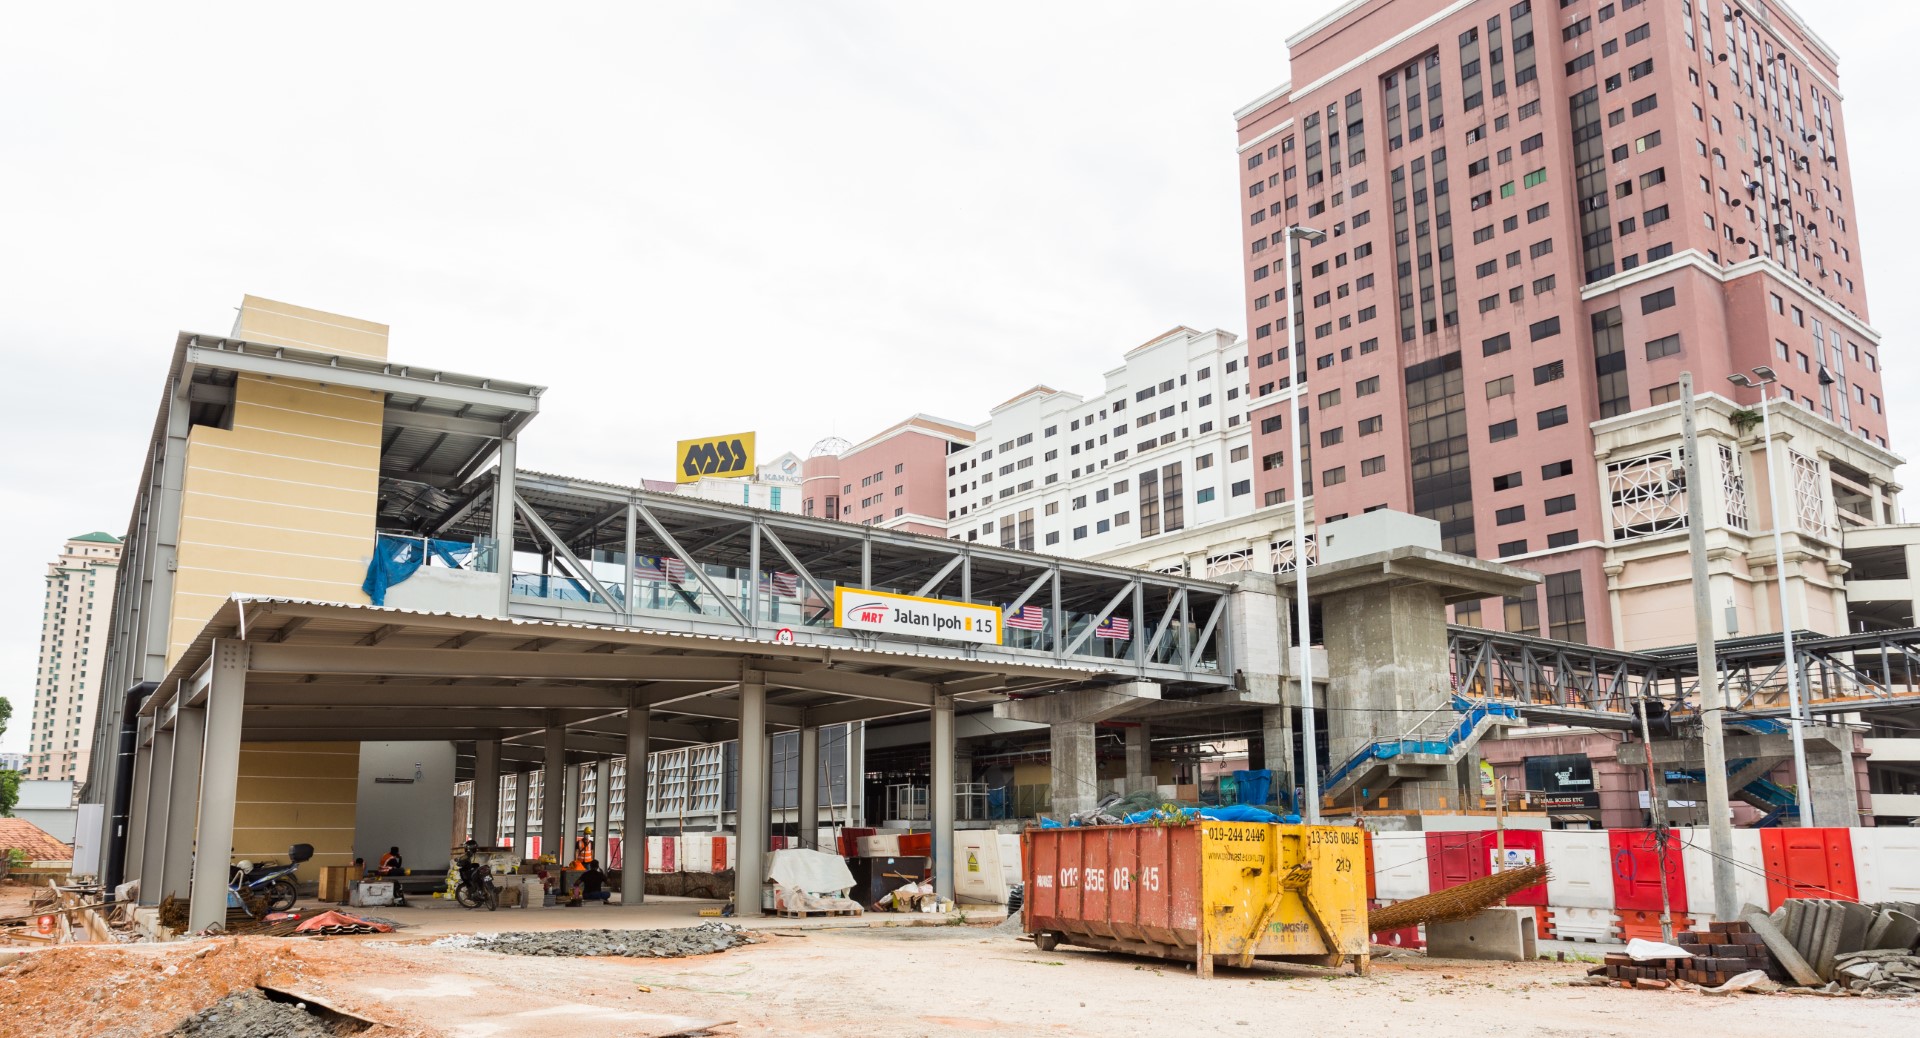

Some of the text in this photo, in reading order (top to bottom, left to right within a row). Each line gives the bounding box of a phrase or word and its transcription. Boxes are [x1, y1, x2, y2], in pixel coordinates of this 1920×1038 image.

[861, 611, 883, 623] MRT
[894, 608, 992, 633] Jalan Ipoh 15
[1209, 827, 1265, 842] 019-244 2446
[1341, 832, 1359, 845] 0845
[1336, 858, 1351, 872] 219
[1084, 867, 1105, 892] 356
[1113, 866, 1129, 892] 08
[1142, 866, 1159, 892] 45
